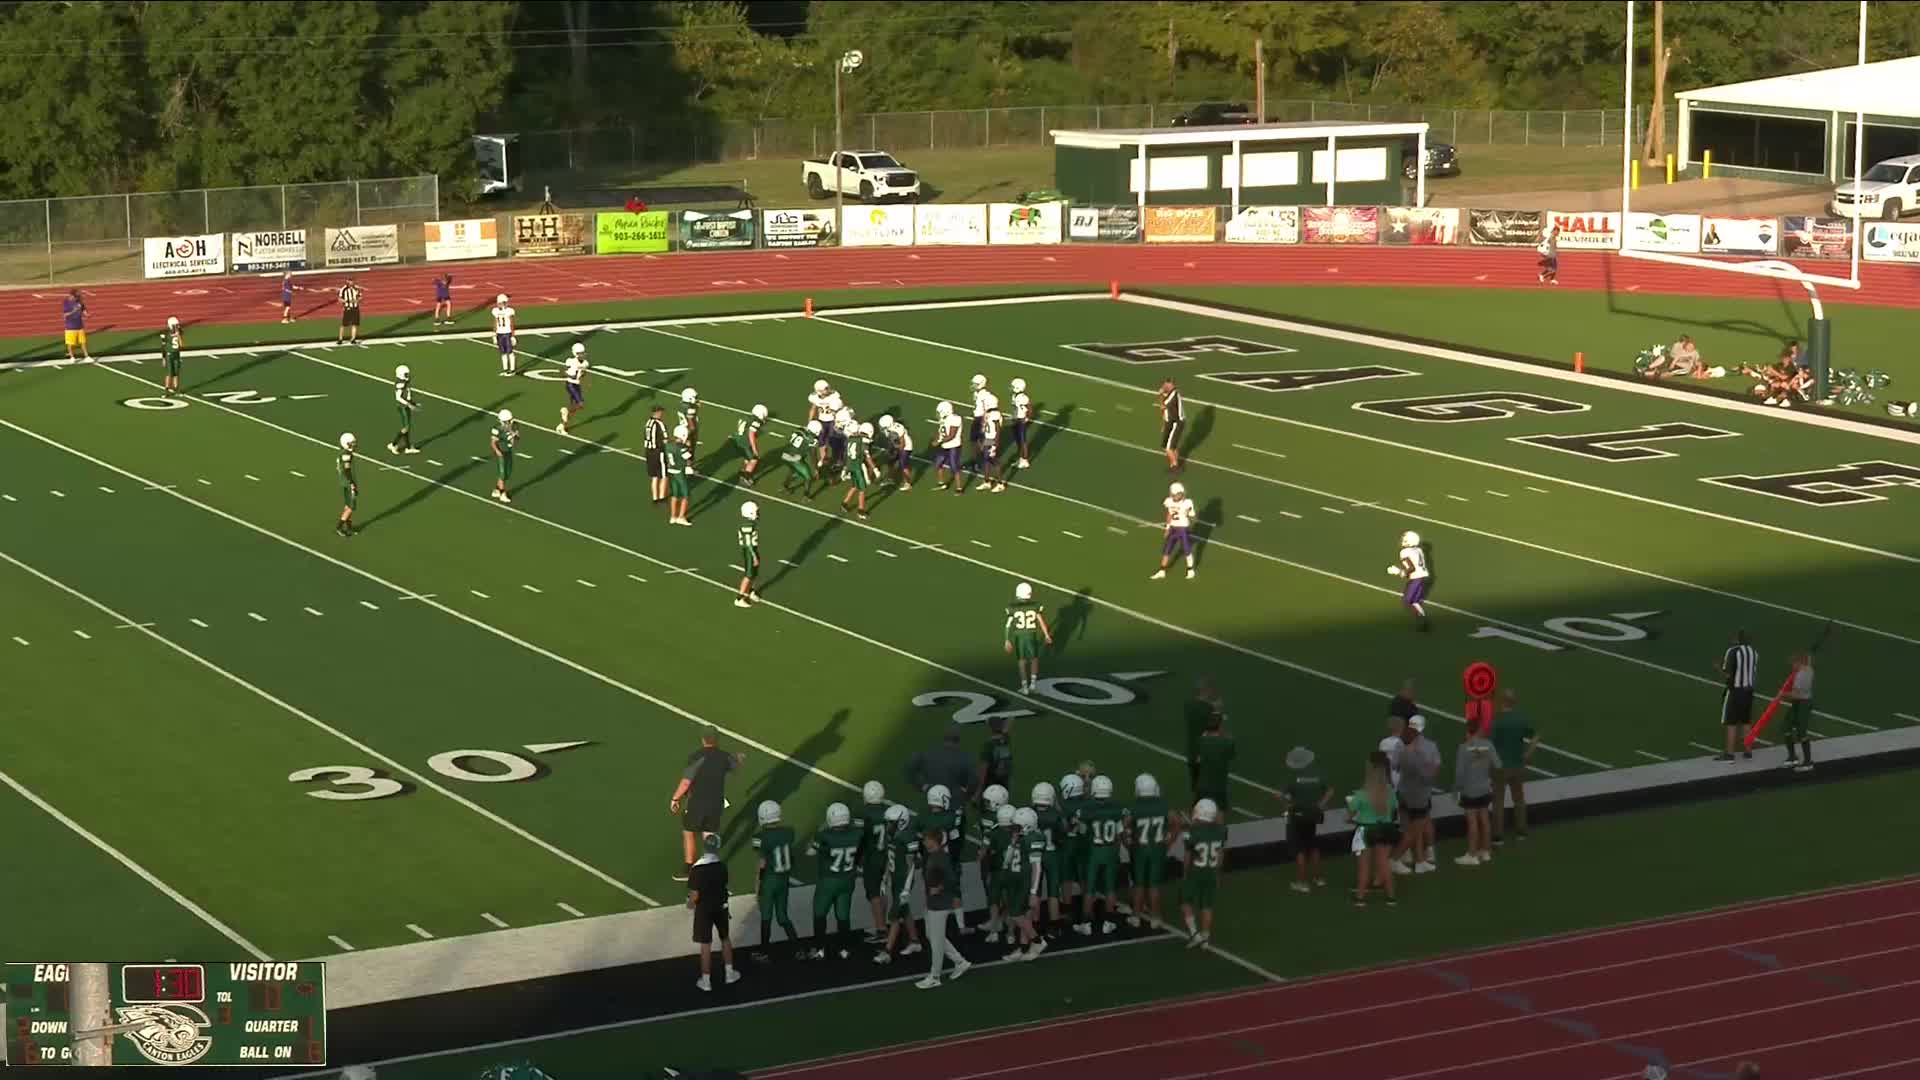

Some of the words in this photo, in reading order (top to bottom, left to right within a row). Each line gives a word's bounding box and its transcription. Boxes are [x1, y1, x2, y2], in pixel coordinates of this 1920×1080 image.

[1554, 216, 1615, 233] HALL
[255, 232, 305, 247] NORRELL
[1013, 610, 1036, 629] 32
[1091, 820, 1116, 845] 10
[1136, 816, 1166, 844] 77
[773, 844, 791, 873] 11
[829, 847, 858, 873] 75
[1194, 841, 1222, 868] 35
